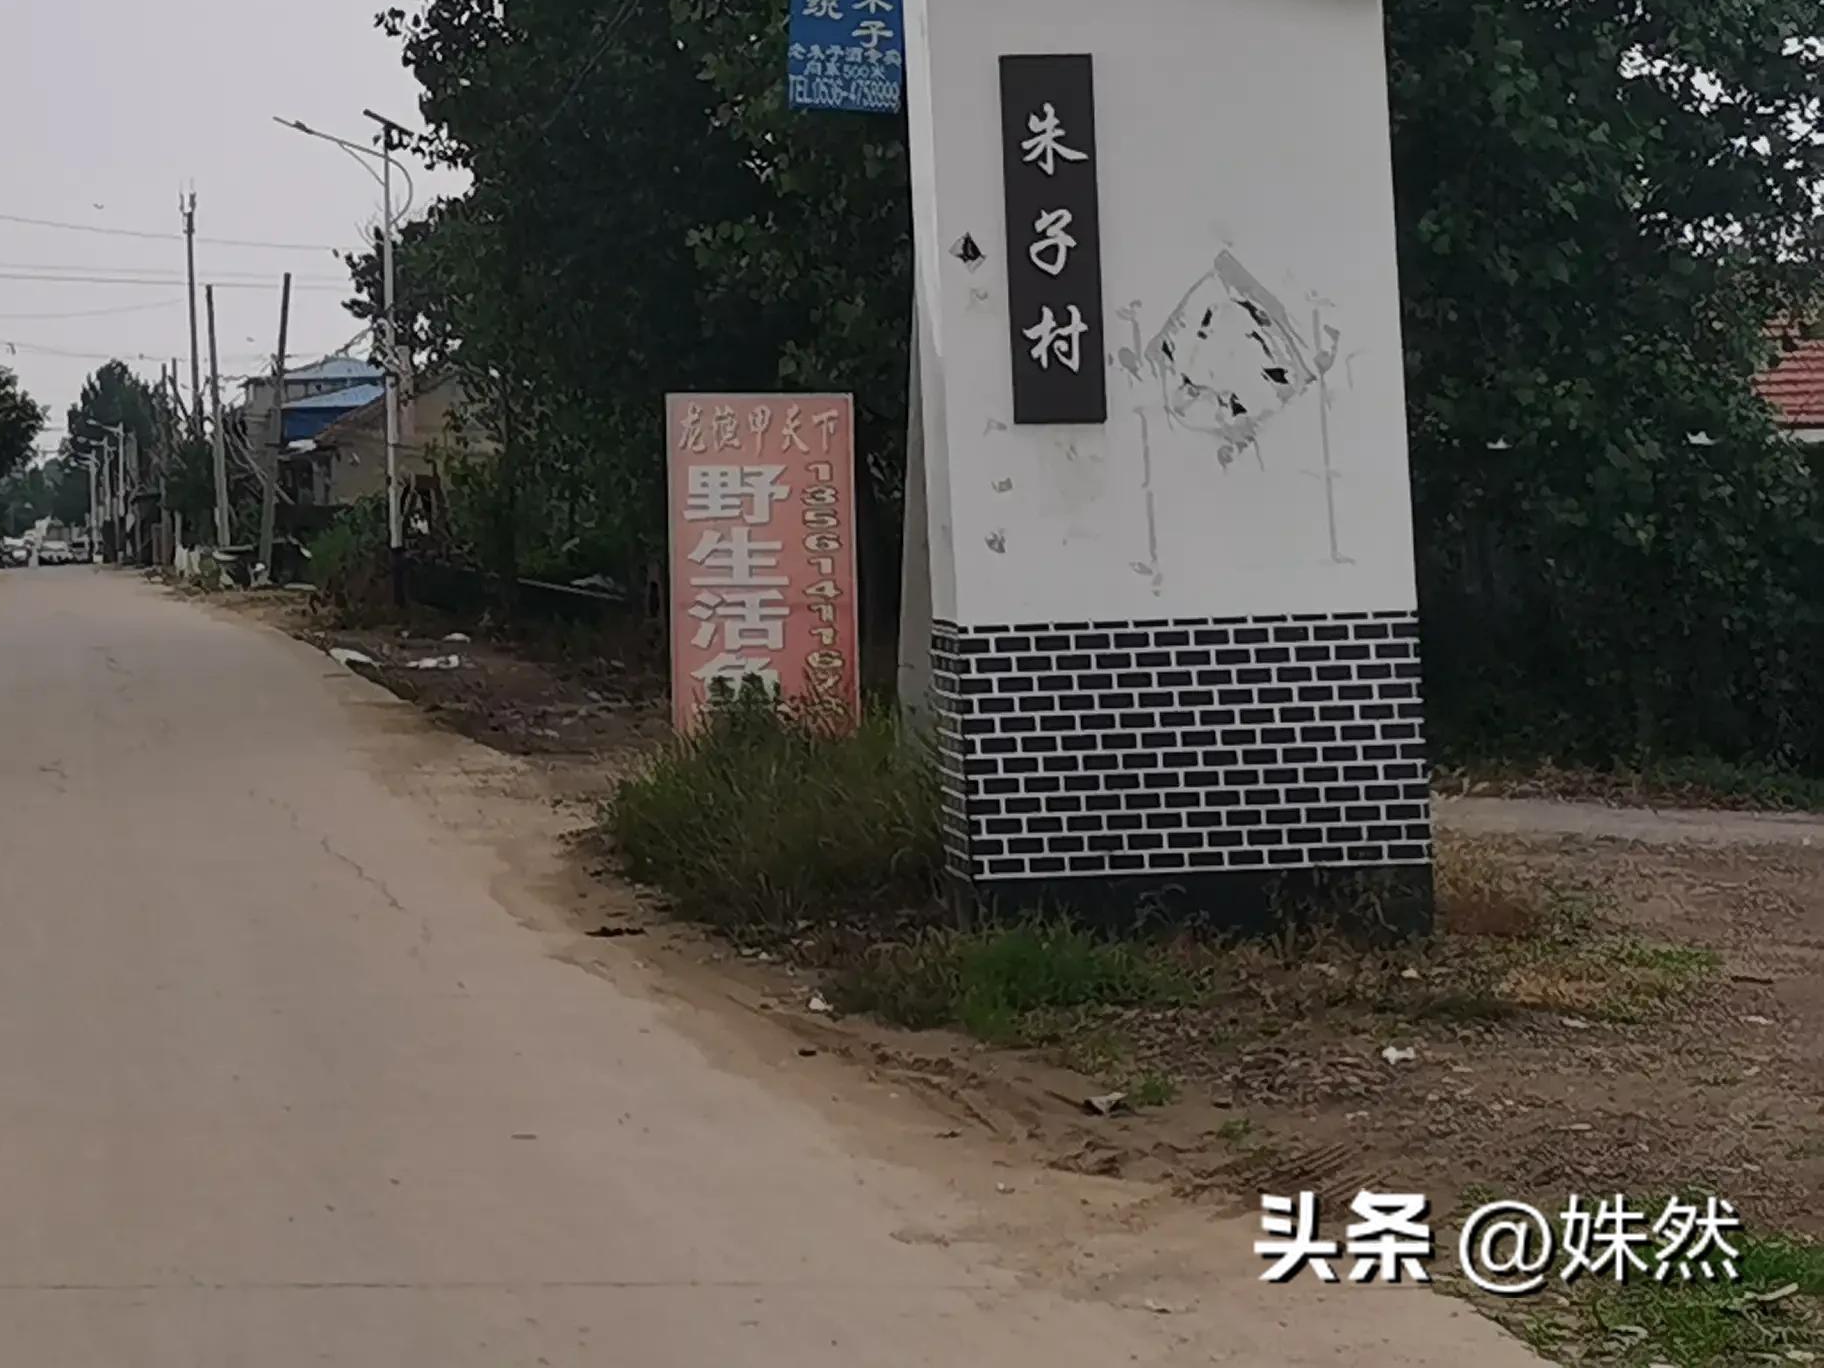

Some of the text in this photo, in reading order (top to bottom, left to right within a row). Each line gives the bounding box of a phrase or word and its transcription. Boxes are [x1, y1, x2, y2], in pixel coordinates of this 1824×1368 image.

[1020, 102, 1089, 376] 朱子村
[682, 465, 792, 702] 野生活鱼
